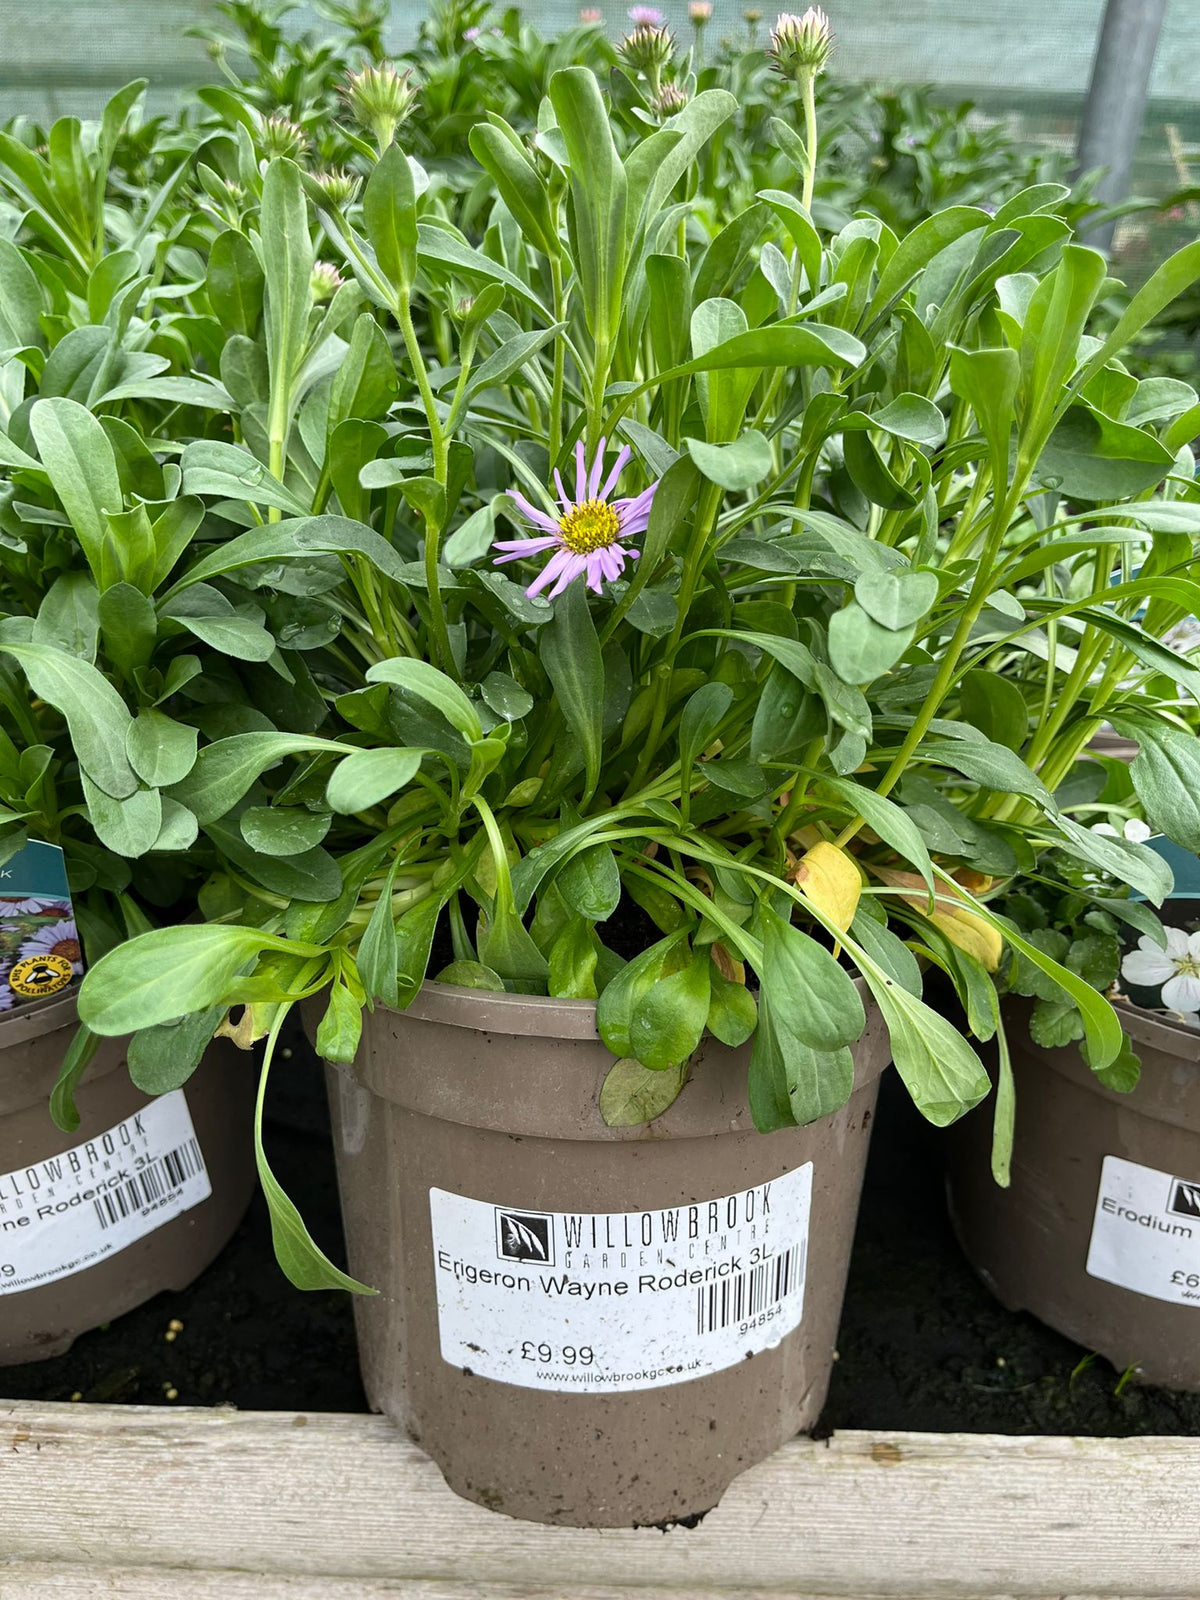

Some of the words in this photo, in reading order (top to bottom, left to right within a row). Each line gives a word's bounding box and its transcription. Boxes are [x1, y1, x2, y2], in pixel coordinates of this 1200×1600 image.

[20, 956, 57, 969] PLANTS
[37, 1169, 129, 1220] Roderick
[134, 1152, 158, 1171] 3L
[563, 1183, 772, 1249] WILLOWBROOK
[1101, 1197, 1193, 1239] Erodium
[564, 1248, 663, 1269] GARDEN
[688, 1217, 770, 1259] CENTRE
[438, 1250, 531, 1292] Erigeron
[539, 1274, 629, 1301] Wayne
[638, 1256, 742, 1294] Roderick
[749, 1243, 774, 1266] 3L
[738, 1303, 782, 1335] 94854
[520, 1341, 594, 1366] £9.99
[536, 1358, 702, 1384] www.willowbrookgc.co.uk
